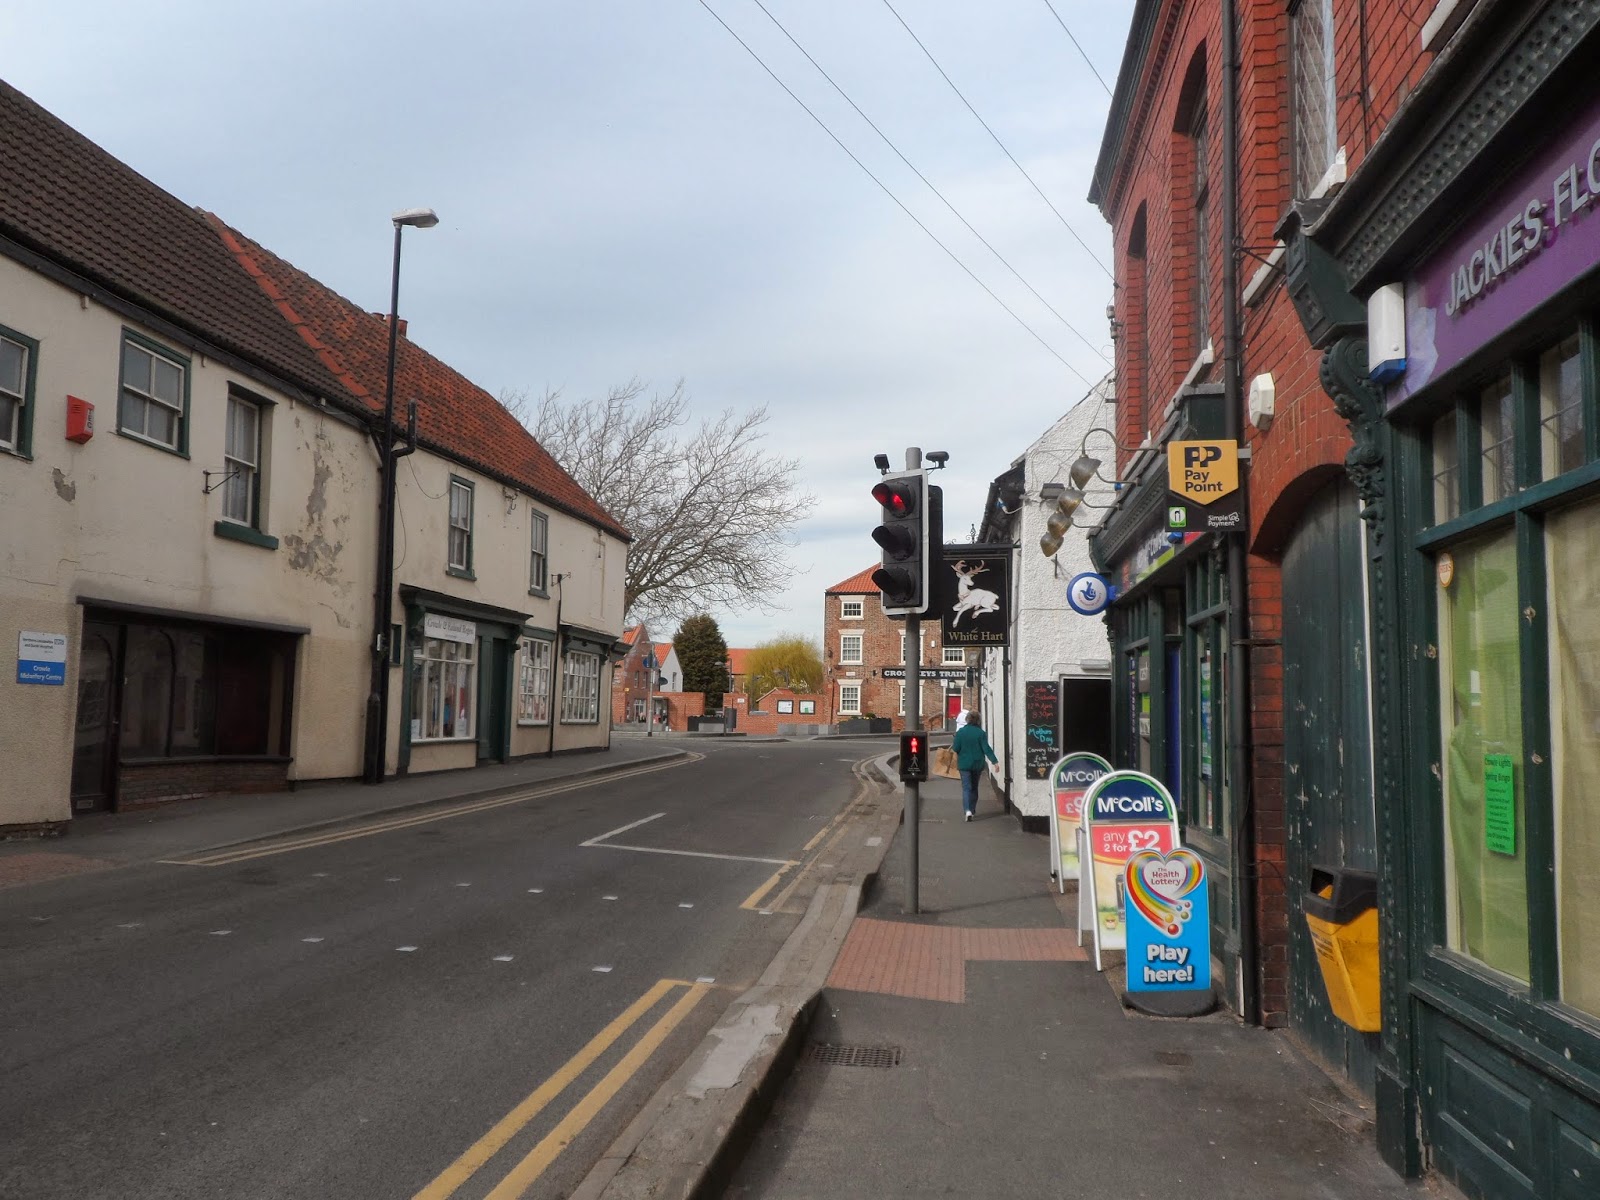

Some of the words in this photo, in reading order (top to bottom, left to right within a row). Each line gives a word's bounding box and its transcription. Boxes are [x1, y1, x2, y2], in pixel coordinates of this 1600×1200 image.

[1445, 199, 1542, 316] JACKIES
[1185, 470, 1210, 482] Pay
[1185, 481, 1223, 492] Point
[1208, 514, 1228, 522] Simple
[1208, 520, 1235, 528] Payment
[948, 631, 979, 641] White
[980, 631, 1004, 641] Hart
[1097, 796, 1165, 813] McColl's
[1103, 832, 1126, 844] any
[1128, 830, 1161, 852] £2
[1104, 844, 1111, 852] 2
[1112, 843, 1128, 852] for
[1151, 878, 1182, 887] Lottery
[1147, 944, 1189, 965] Play
[1143, 965, 1193, 983] here!
